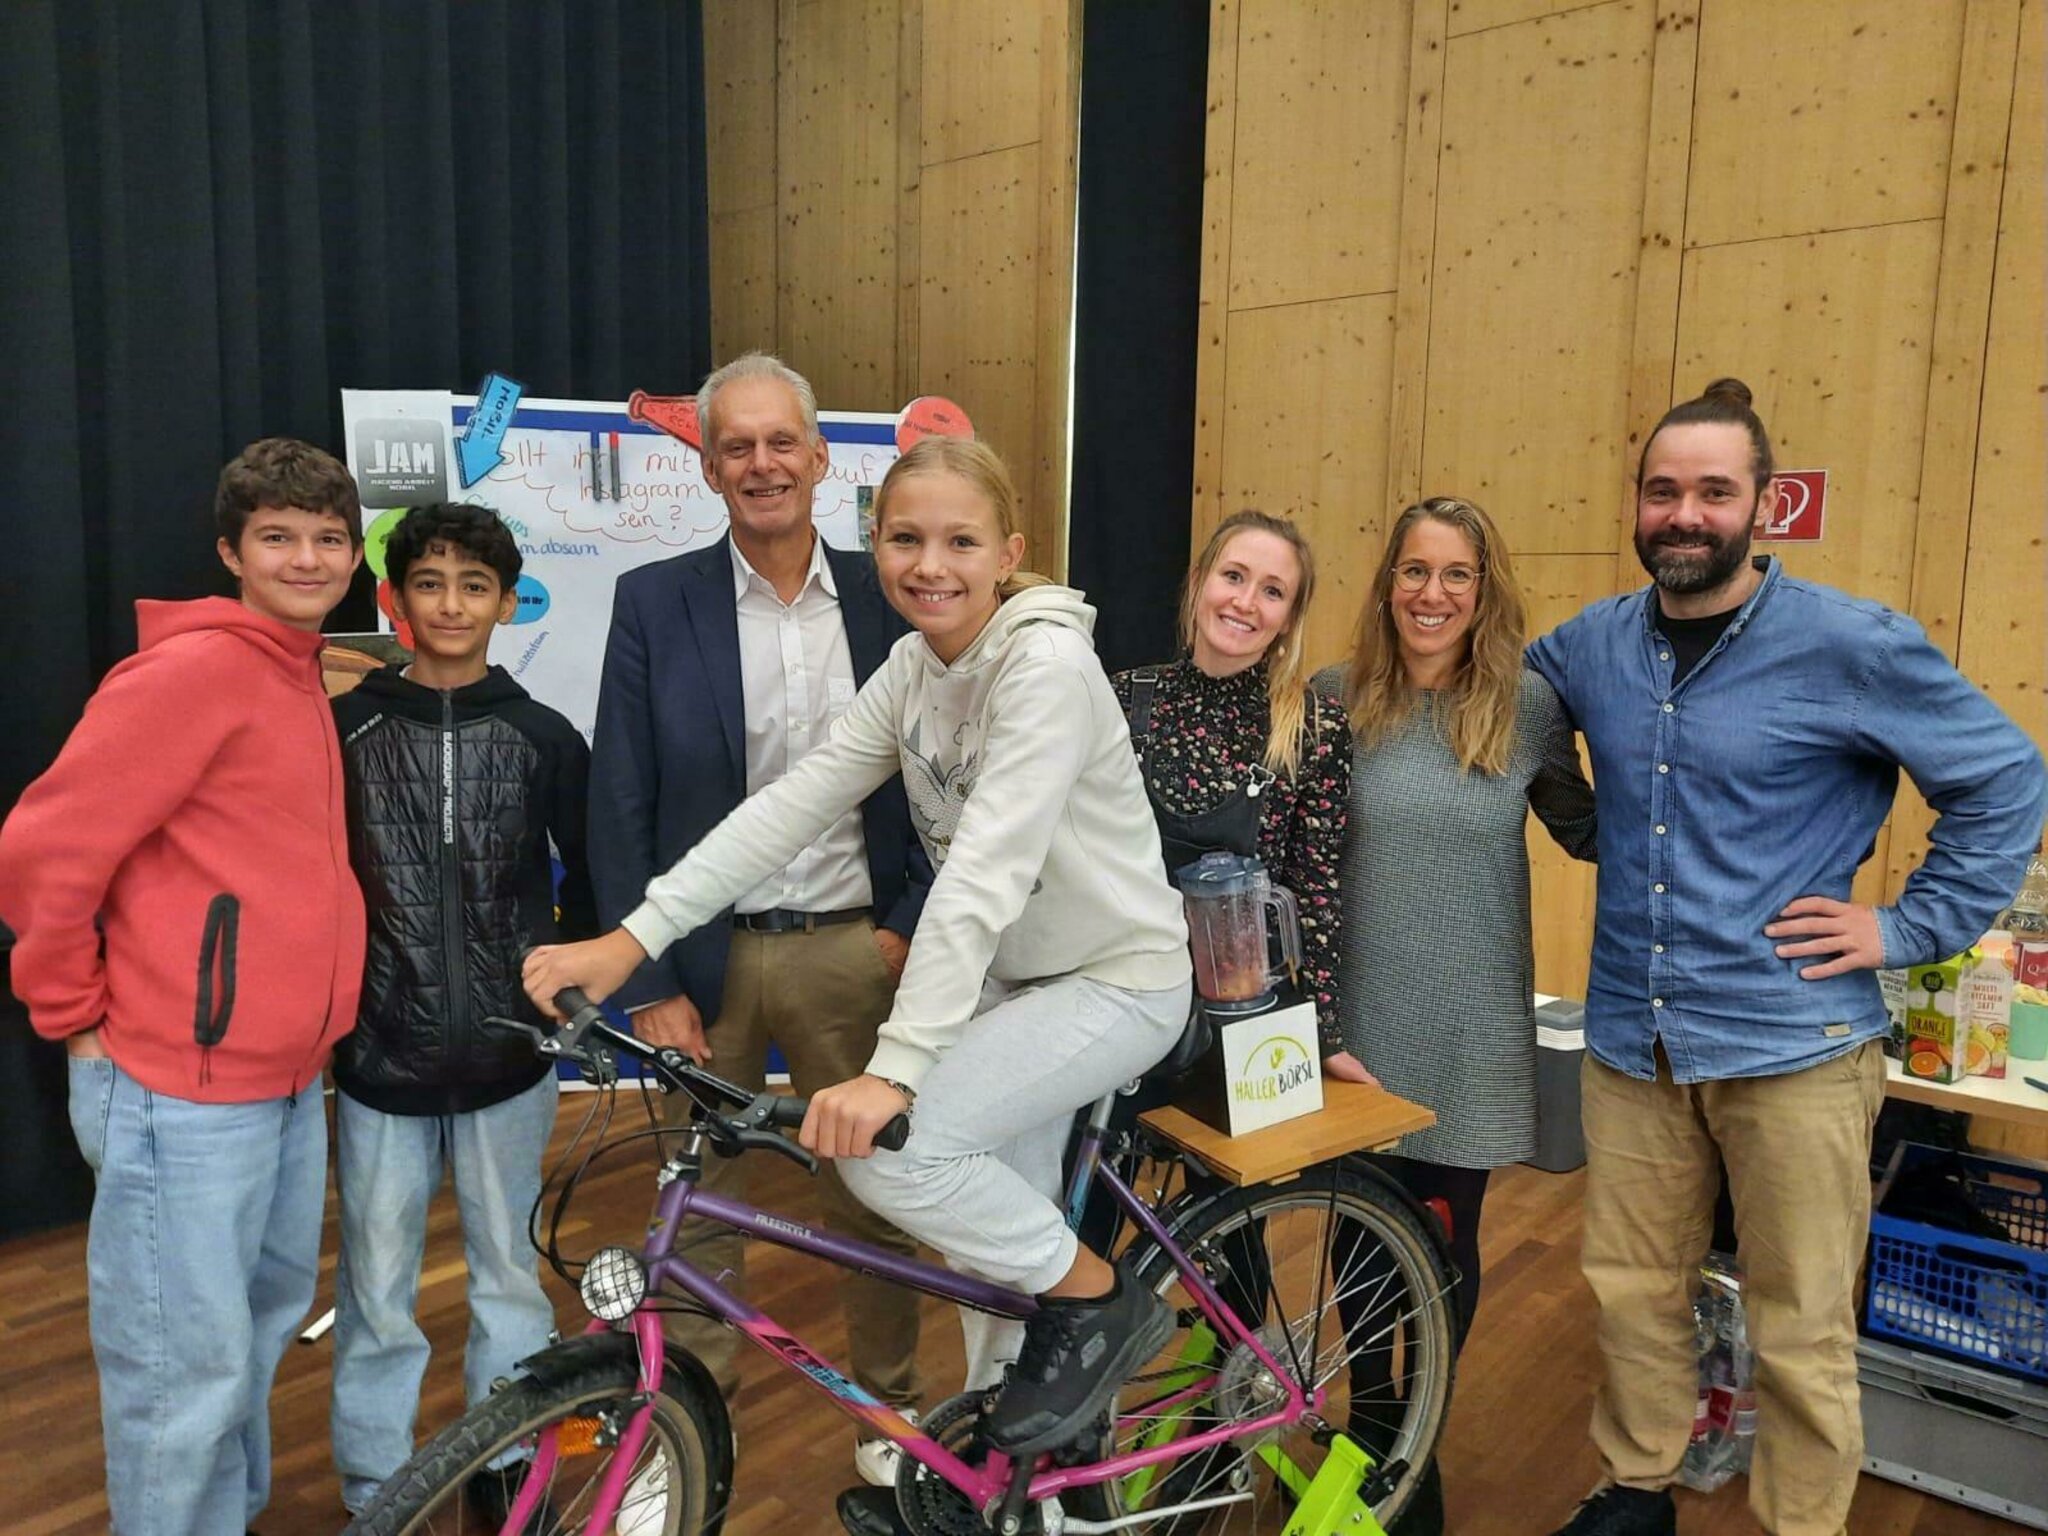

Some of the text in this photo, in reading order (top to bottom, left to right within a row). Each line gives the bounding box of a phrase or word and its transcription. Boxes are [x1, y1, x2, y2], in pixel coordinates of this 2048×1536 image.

[365, 439, 435, 474] JAM
[500, 439, 548, 467] ollt
[646, 442, 693, 473] mit
[580, 475, 704, 513] Insagram
[614, 511, 665, 529] sein
[1911, 1015, 1947, 1036] ORANGE
[1234, 1074, 1277, 1102] HALLER
